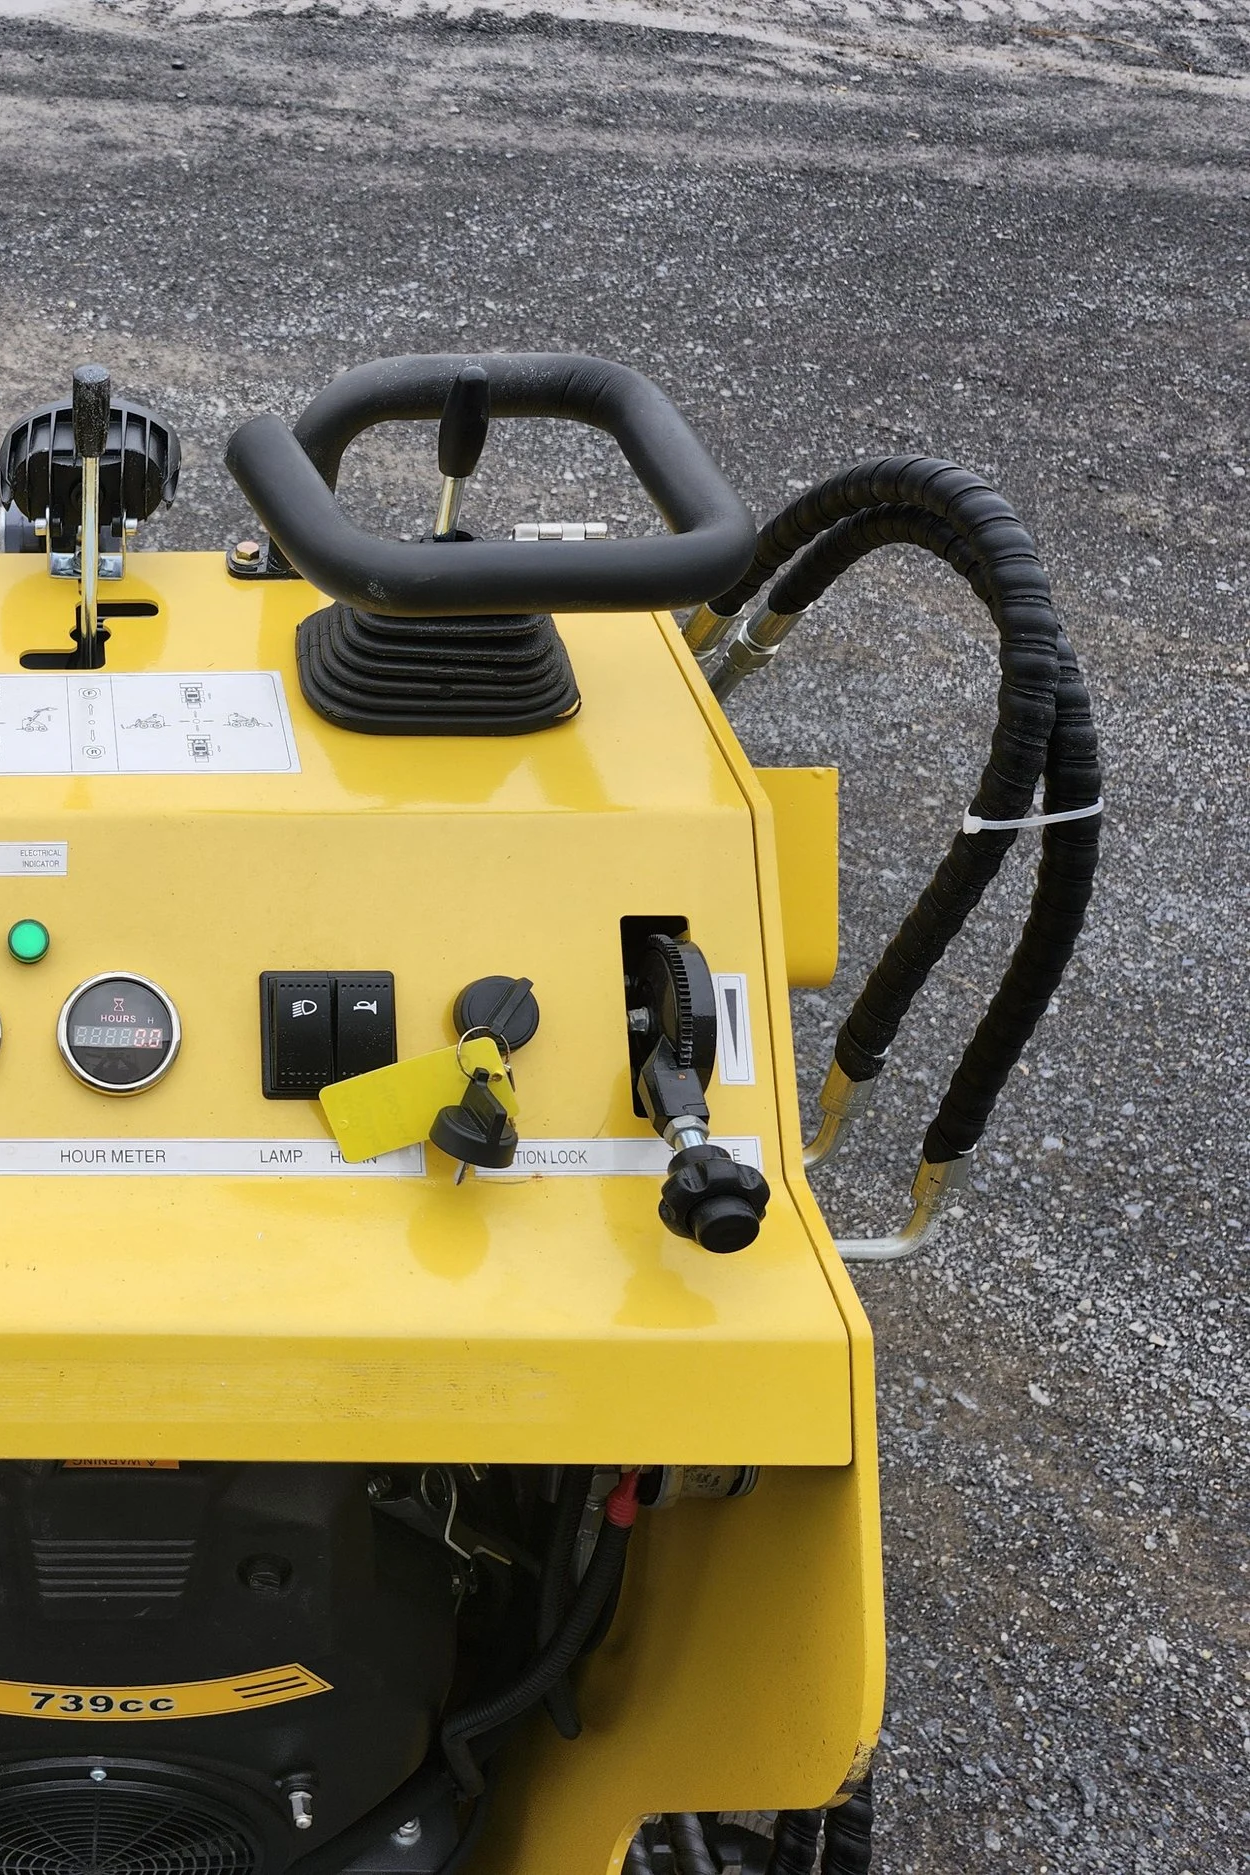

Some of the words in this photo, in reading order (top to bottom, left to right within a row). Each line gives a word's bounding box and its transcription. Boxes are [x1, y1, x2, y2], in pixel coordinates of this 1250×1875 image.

[20, 849, 62, 857] ELECTRICAL
[22, 860, 60, 868] INDICATOR
[100, 1014, 137, 1024] HOURS
[60, 1149, 107, 1164] HOUR
[110, 1149, 166, 1164] METER
[259, 1149, 303, 1164] LAMP
[550, 1149, 588, 1165] LOCK
[30, 1691, 176, 1713] 739cc
